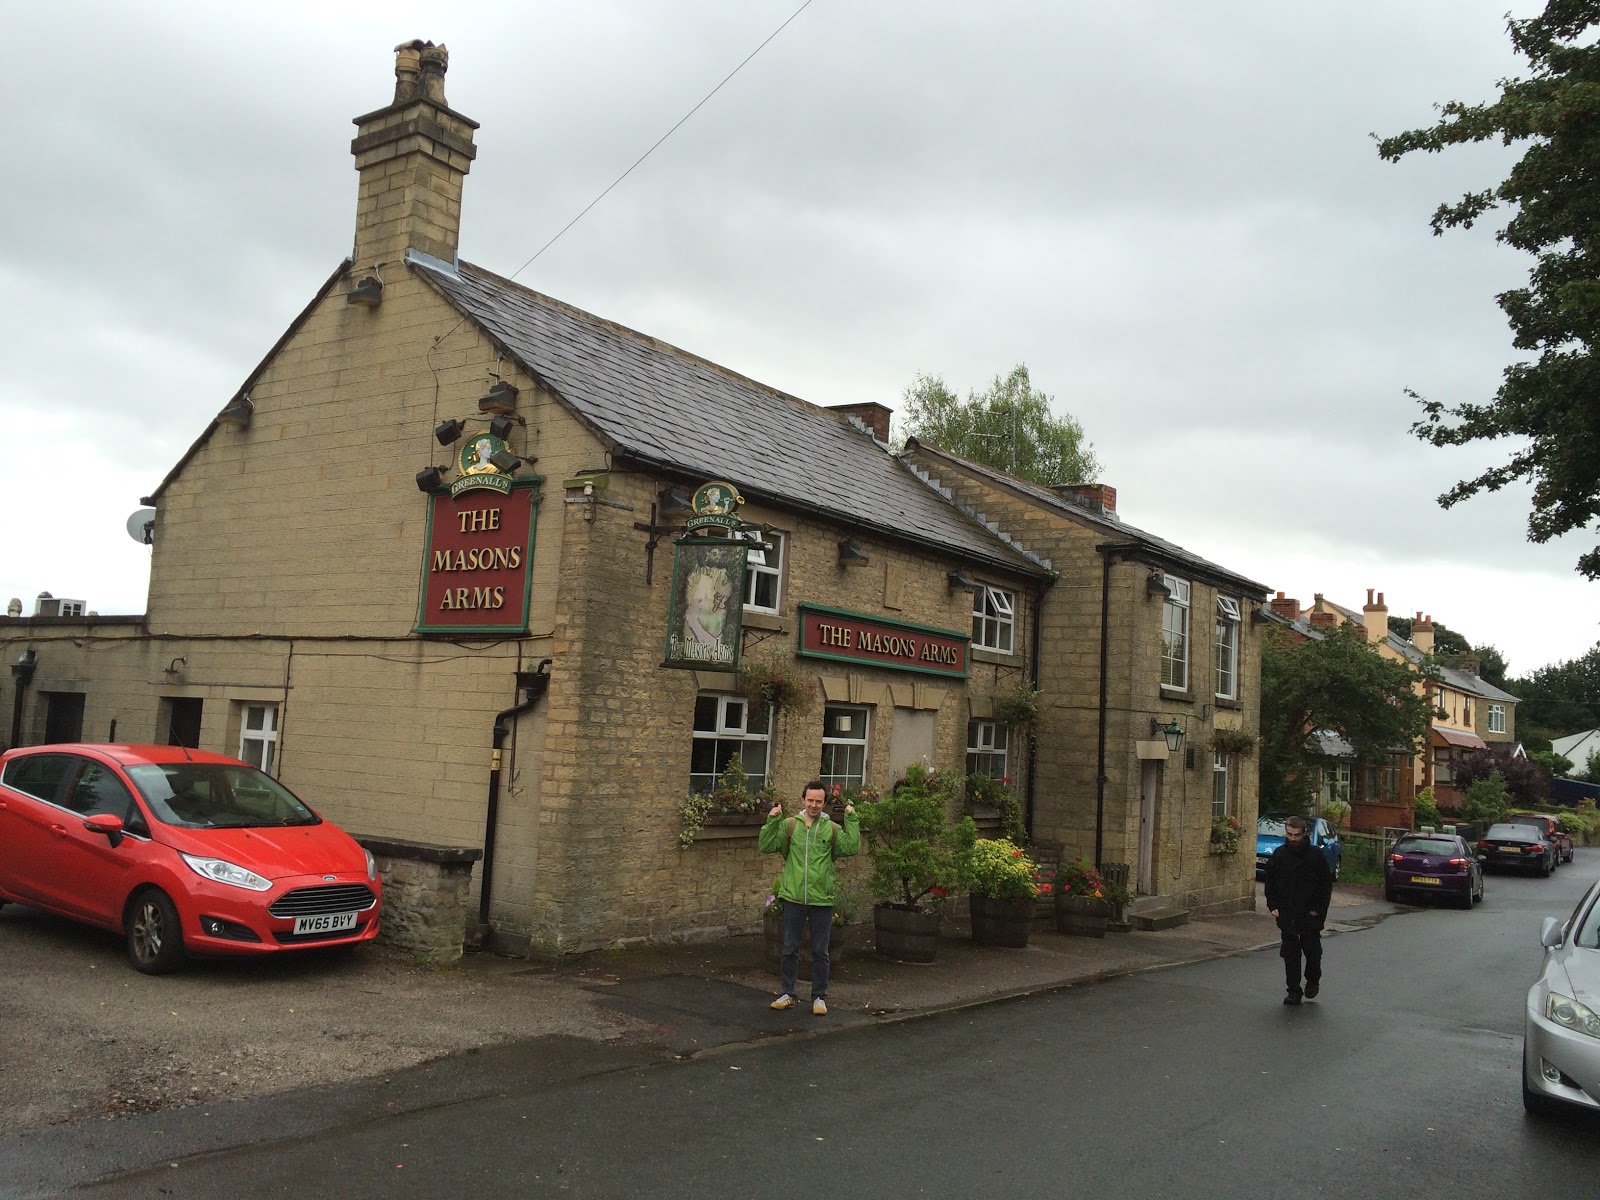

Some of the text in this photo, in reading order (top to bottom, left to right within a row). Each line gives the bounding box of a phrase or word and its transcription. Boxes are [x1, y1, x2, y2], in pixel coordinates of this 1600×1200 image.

[457, 508, 502, 533] THE
[431, 546, 522, 572] MASONS
[439, 586, 505, 611] ARMS
[819, 623, 957, 665] THE MASONS ARMS
[299, 914, 353, 931] MV65 BVY
